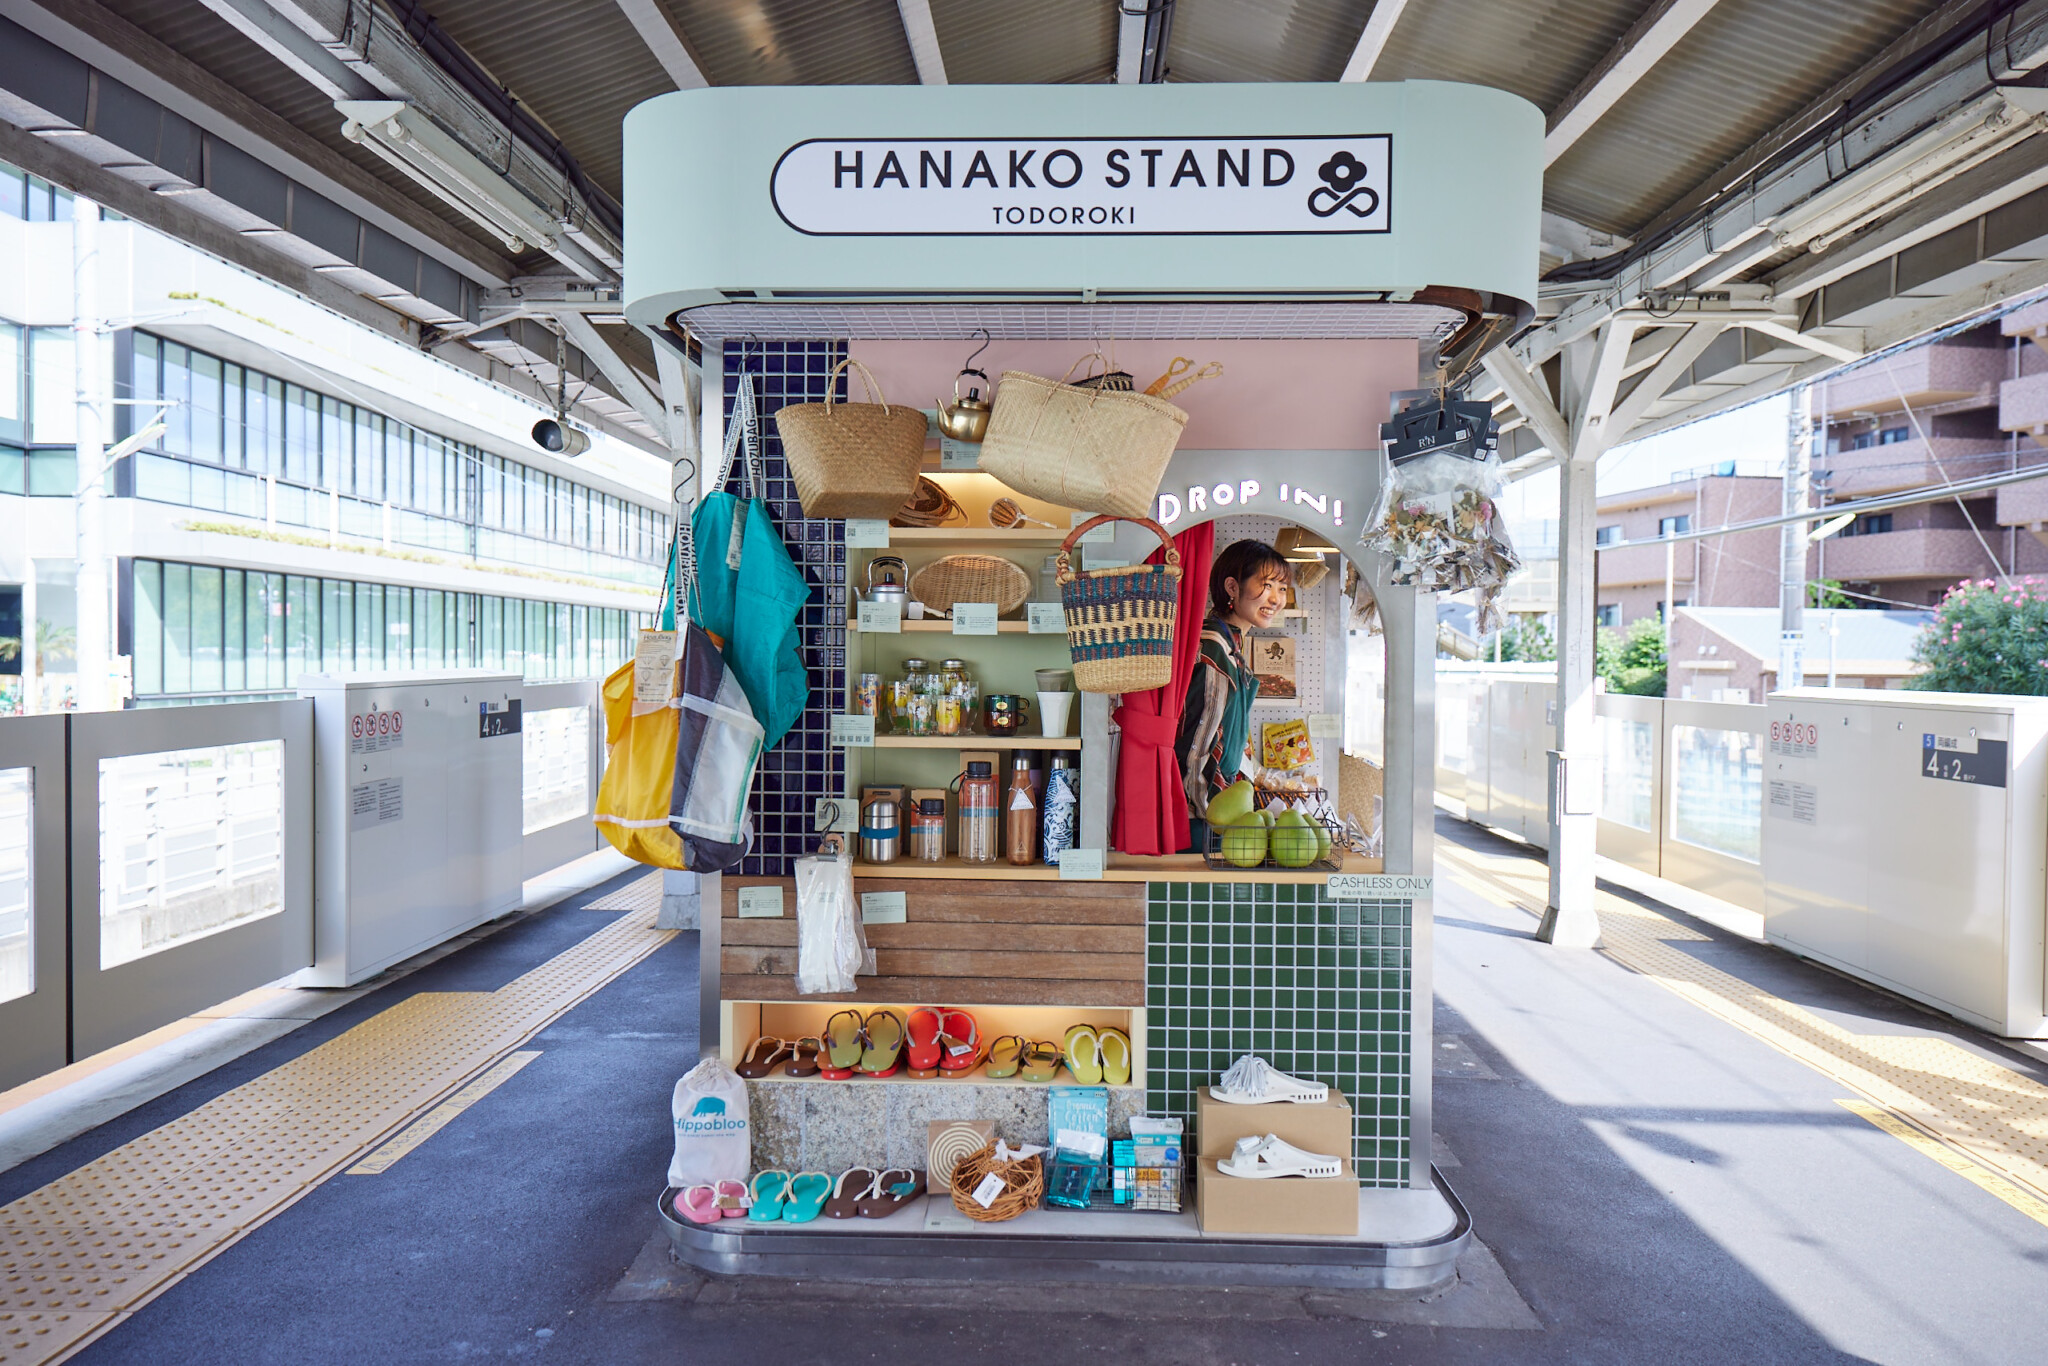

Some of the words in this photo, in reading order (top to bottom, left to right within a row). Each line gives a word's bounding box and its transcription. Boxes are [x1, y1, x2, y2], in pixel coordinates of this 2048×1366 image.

[834, 148, 1083, 188] HANAKO
[1105, 147, 1297, 188] STAND
[992, 204, 1136, 225] TODOROKI
[745, 419, 761, 476] HOZUBAG
[1158, 479, 1261, 526] DROP
[1279, 483, 1344, 527] IN!
[482, 715, 489, 736] 4
[495, 718, 501, 735] 2
[1926, 736, 1932, 747] 5
[1926, 751, 1939, 777] 4
[1952, 759, 1962, 780] 2
[1329, 876, 1393, 889] CASHLESS
[1396, 878, 1433, 889] ONLY
[674, 1118, 746, 1133] Hippobloo
